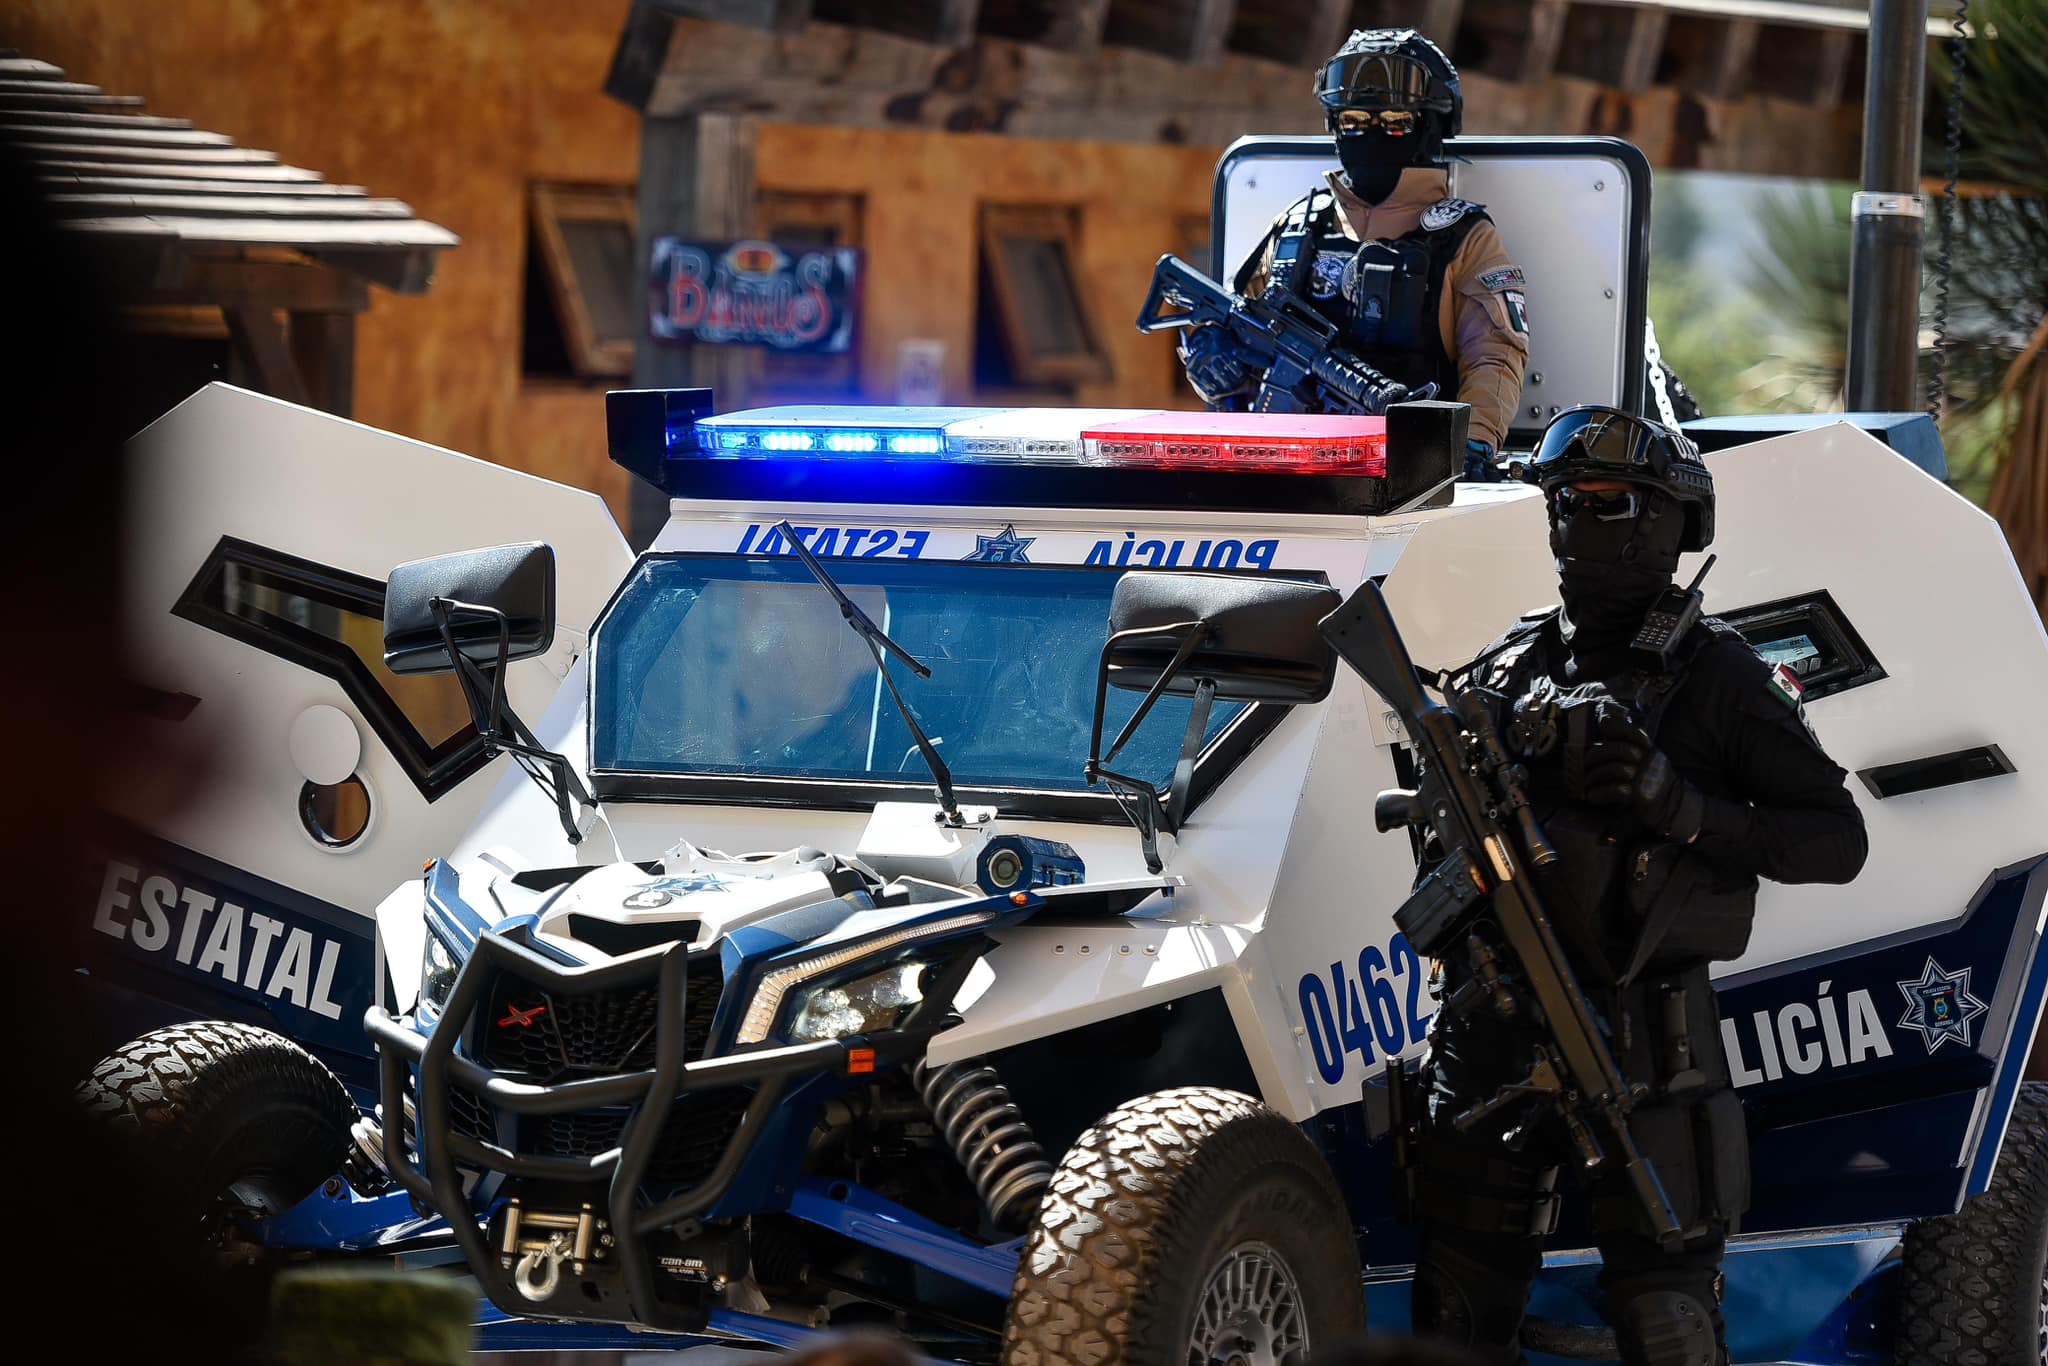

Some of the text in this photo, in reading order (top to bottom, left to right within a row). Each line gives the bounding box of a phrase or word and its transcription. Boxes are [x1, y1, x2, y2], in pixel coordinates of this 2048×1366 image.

[93, 859, 341, 1020] ESTATAL
[1298, 931, 1433, 1085] 0462
[1719, 980, 1894, 1088] LICÍA
